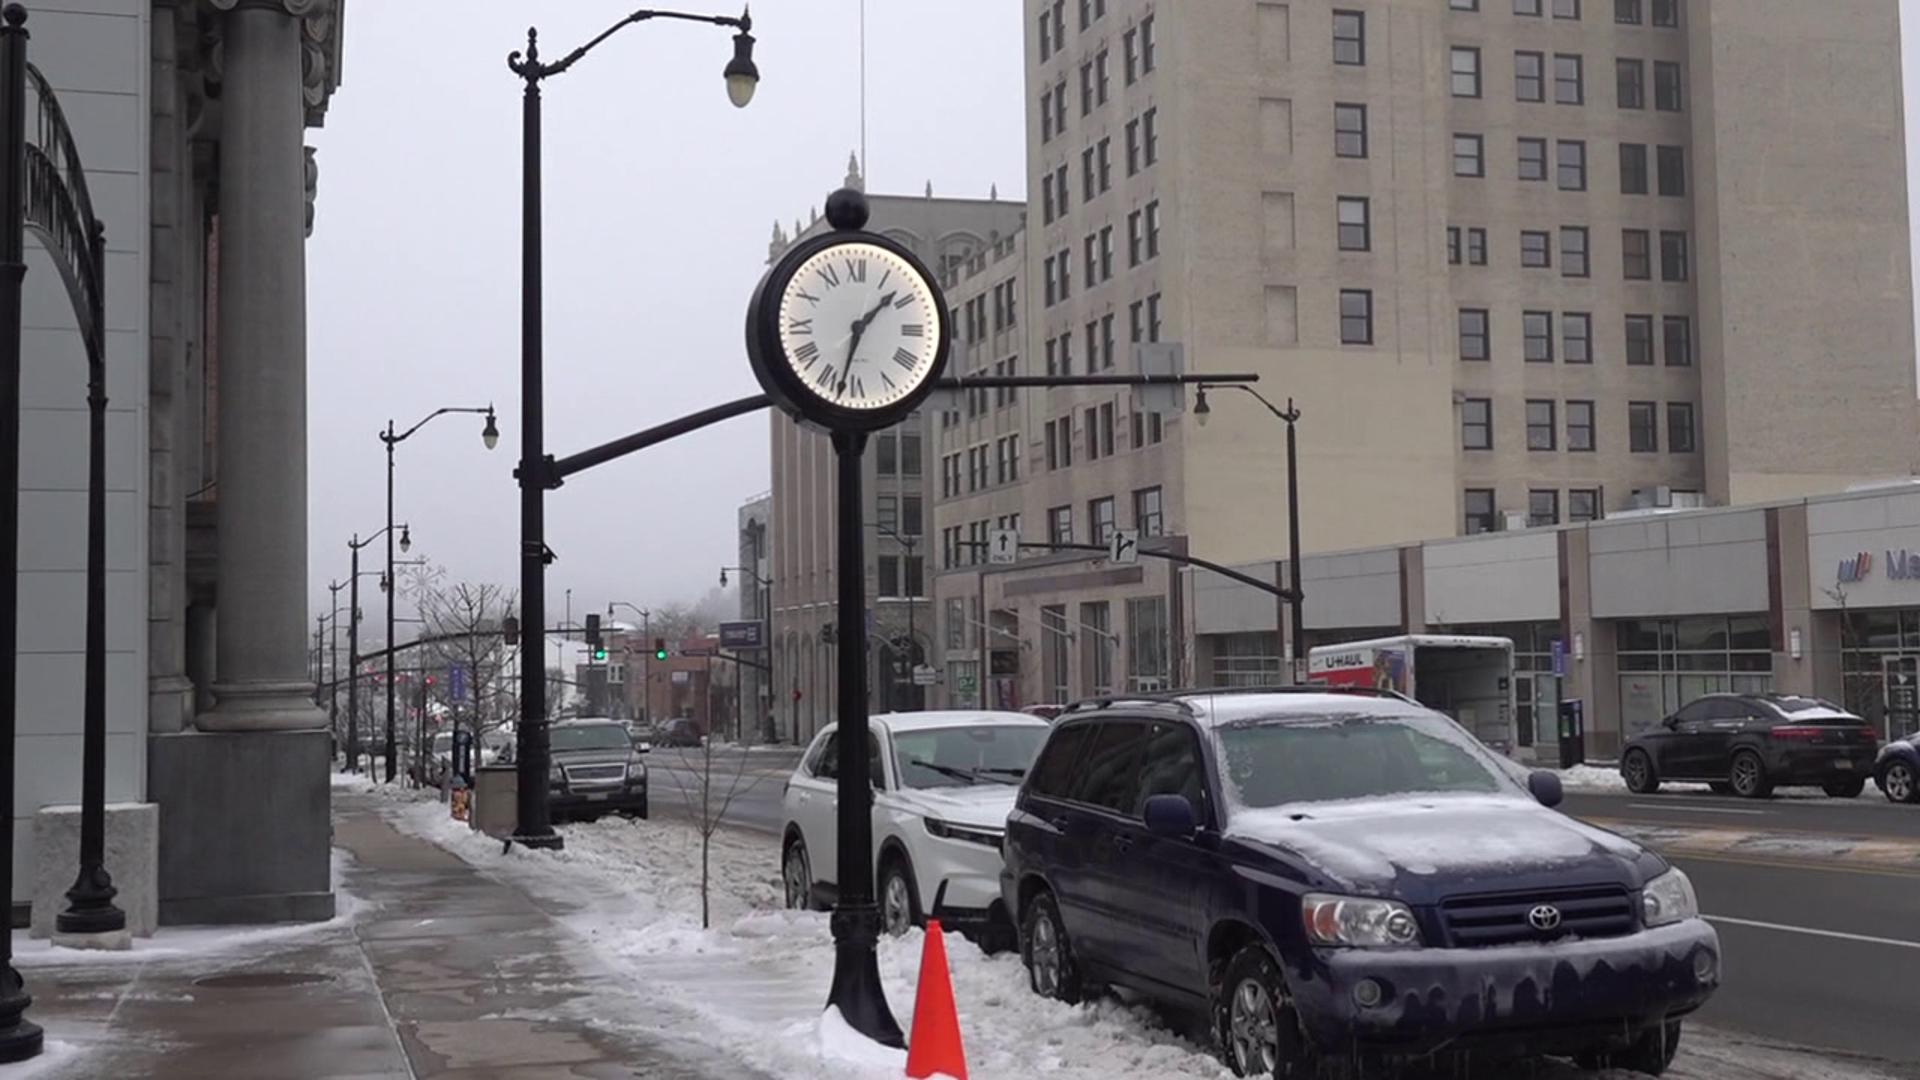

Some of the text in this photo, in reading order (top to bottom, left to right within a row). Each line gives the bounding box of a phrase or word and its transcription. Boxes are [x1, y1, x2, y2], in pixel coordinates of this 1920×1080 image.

[816, 263, 840, 291] XI
[846, 259, 866, 283] XII
[878, 270, 891, 290] I
[796, 287, 820, 308] X
[894, 293, 916, 310] II
[789, 317, 813, 335] IX
[902, 324, 924, 337] III
[794, 341, 820, 371] VIII
[816, 364, 838, 393] VII
[851, 374, 865, 399] VI
[880, 371, 896, 393] V
[992, 554, 1013, 563] ONLY
